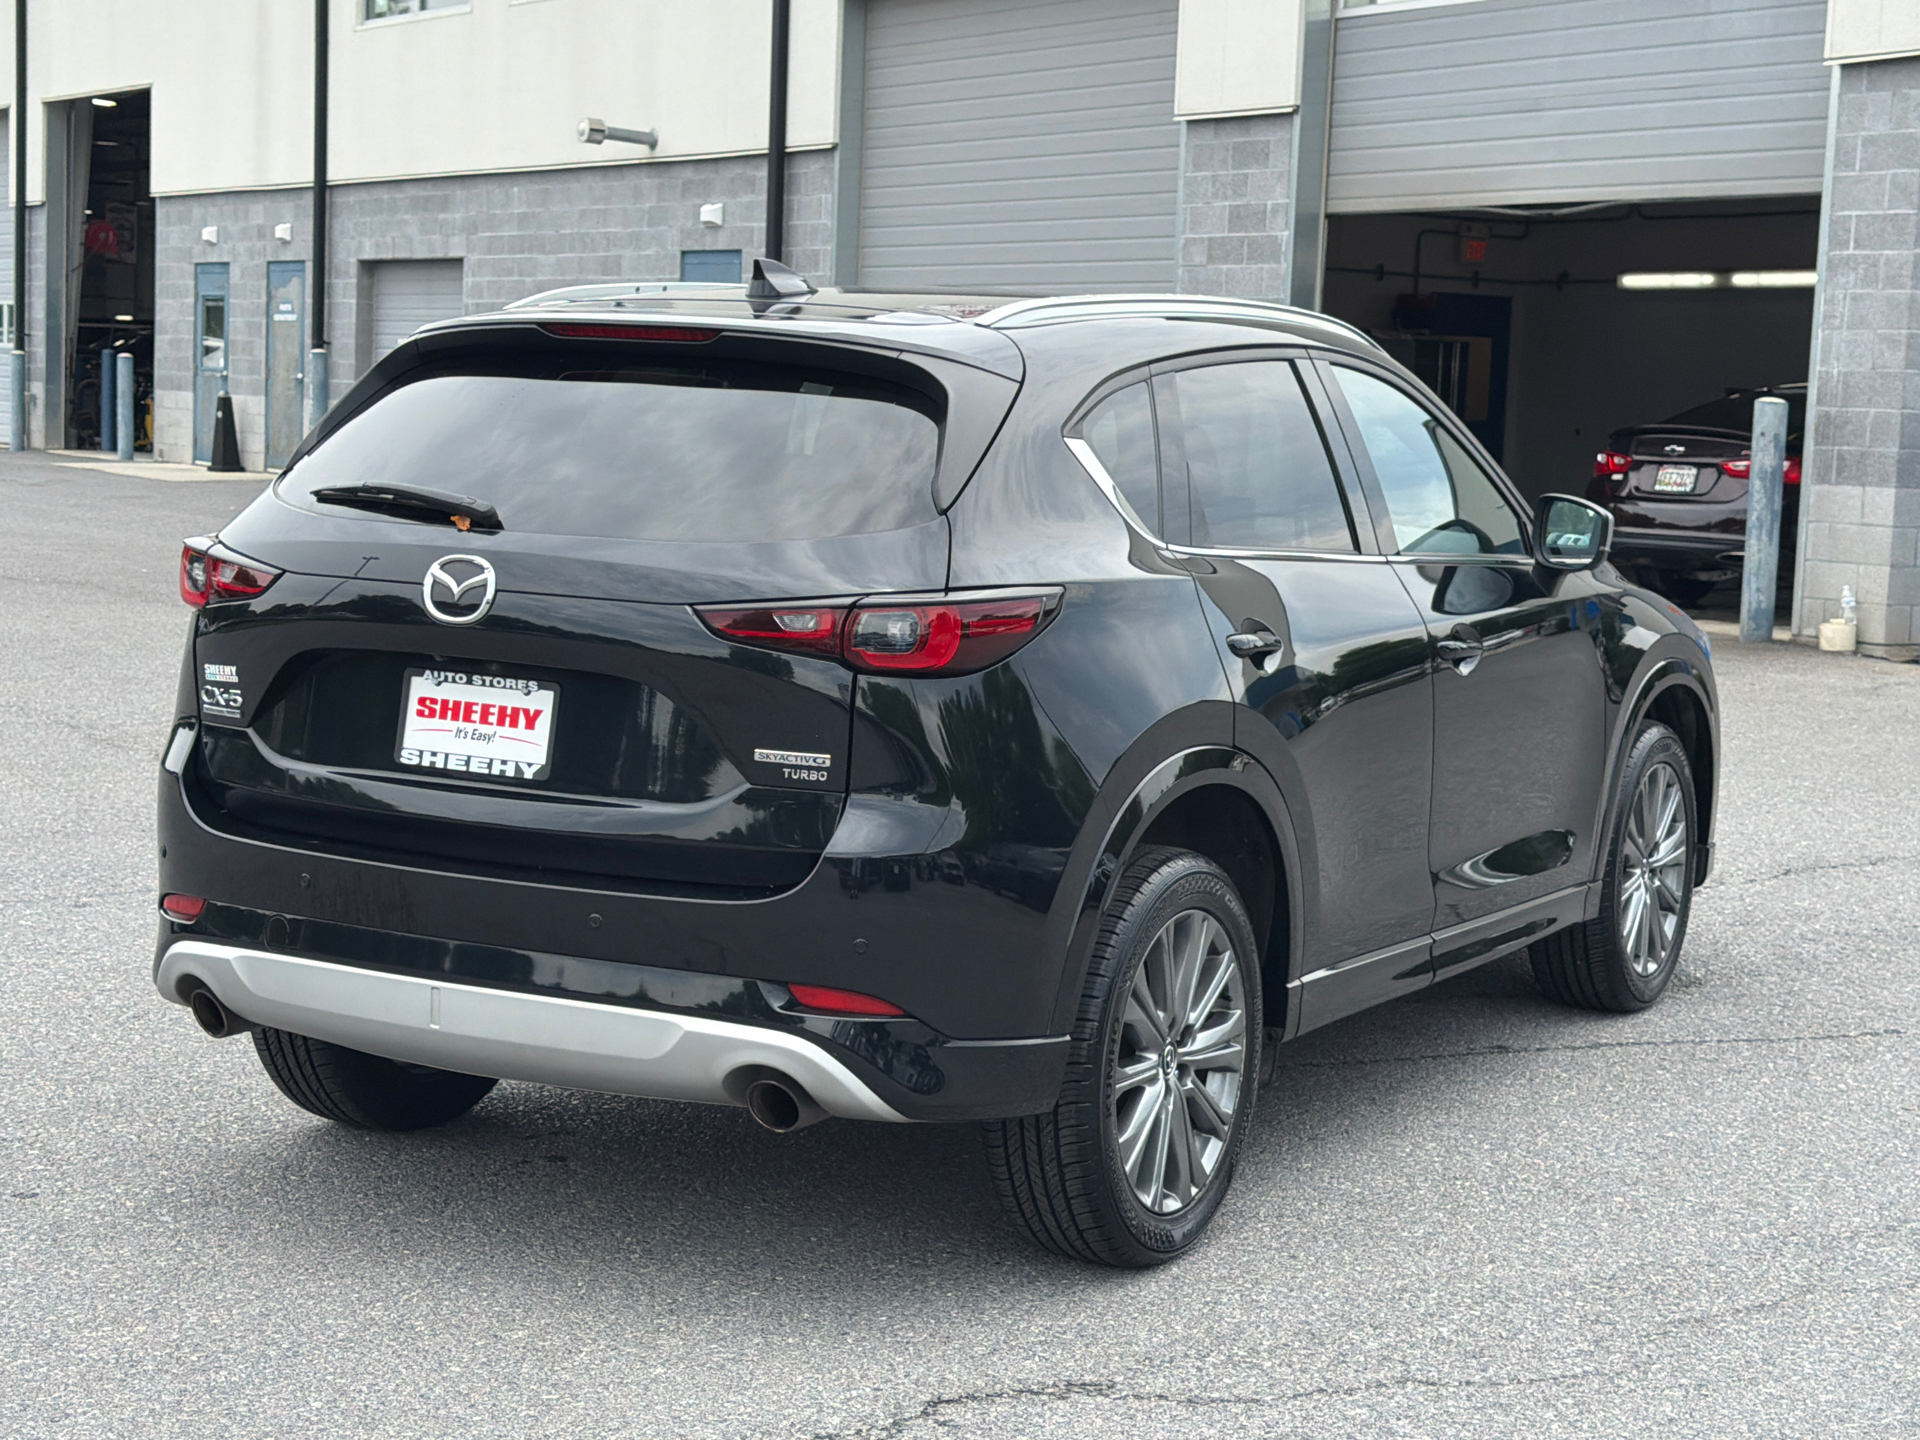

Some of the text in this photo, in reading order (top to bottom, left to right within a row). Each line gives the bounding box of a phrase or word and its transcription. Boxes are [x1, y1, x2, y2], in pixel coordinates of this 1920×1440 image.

[204, 663, 237, 676] SHEEHY
[423, 670, 539, 692] AUTO STORES
[201, 685, 243, 707] CX-5
[416, 696, 544, 731] SHEEHY
[454, 726, 497, 745] It's Easy!
[400, 749, 542, 779] SHEEHY
[782, 768, 828, 781] TURBO
[1105, 1016, 1120, 1120] KUMHO
